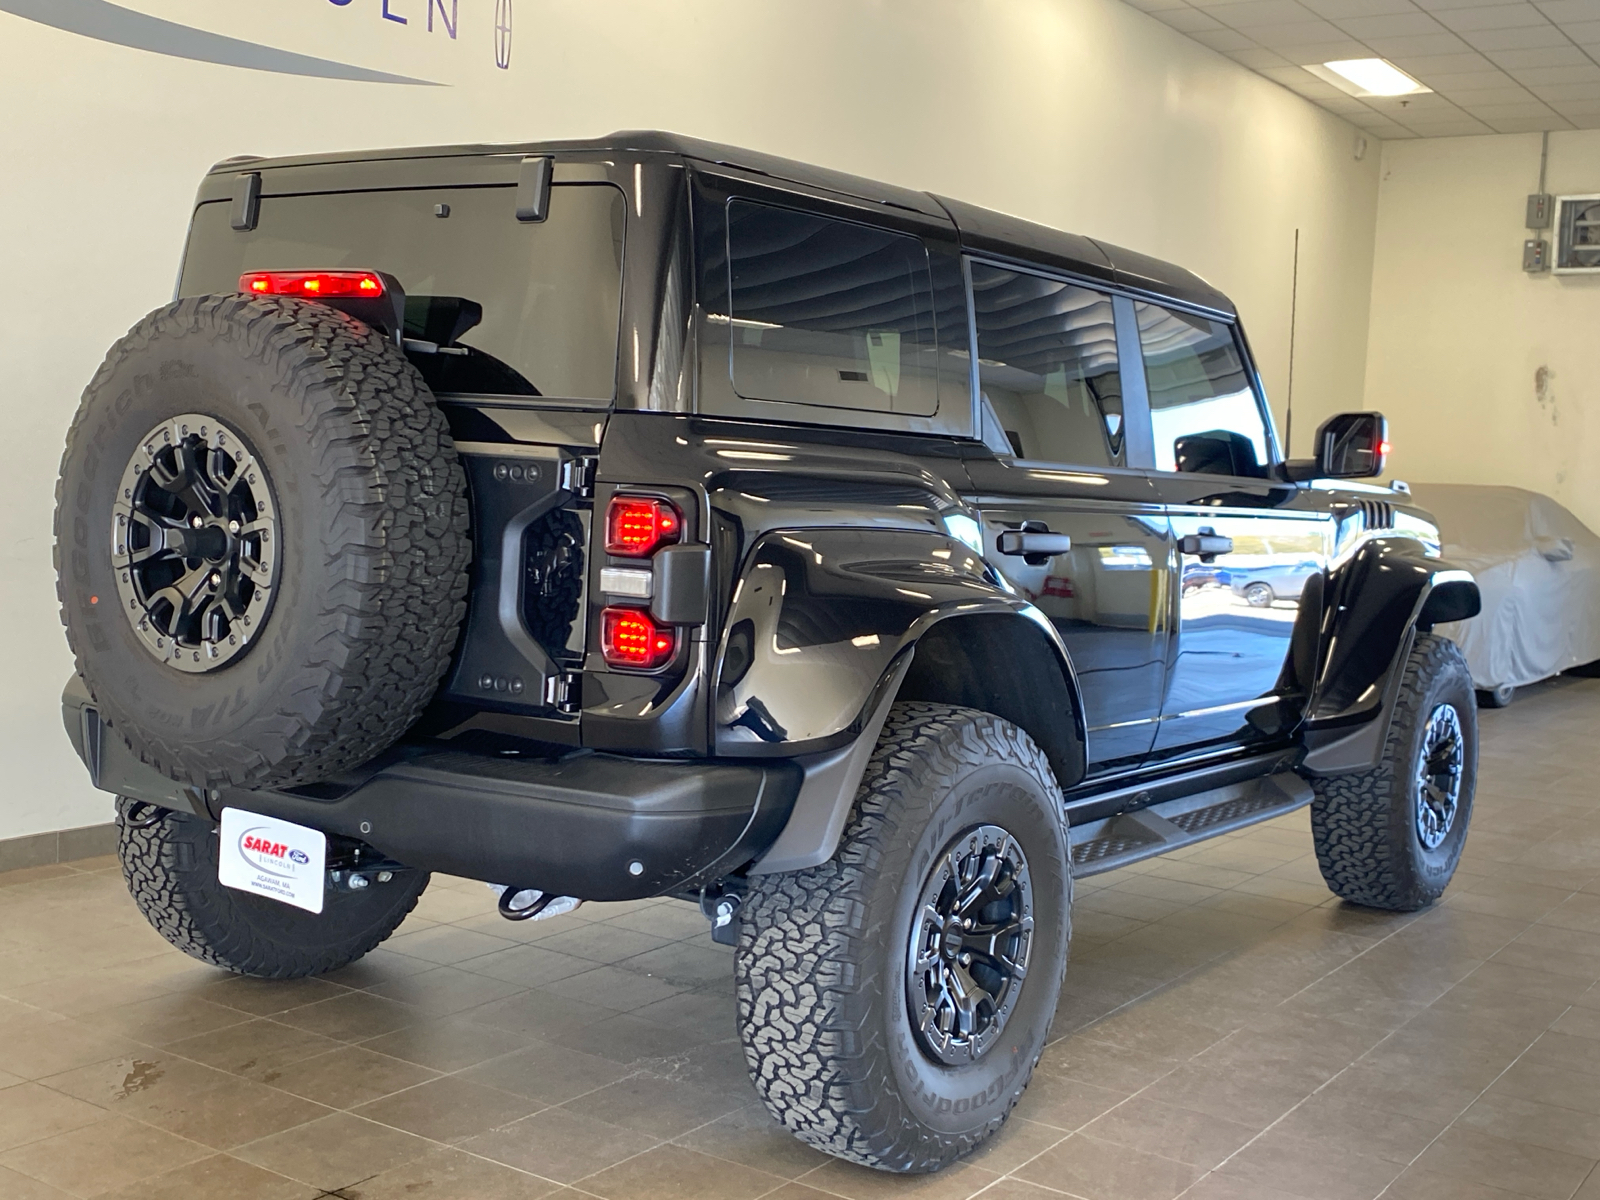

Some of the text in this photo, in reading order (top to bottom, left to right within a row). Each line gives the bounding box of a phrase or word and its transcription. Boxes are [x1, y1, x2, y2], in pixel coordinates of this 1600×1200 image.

[243, 835, 288, 858] SARAT
[263, 857, 291, 869] LINCOLN
[289, 849, 309, 865] Ford
